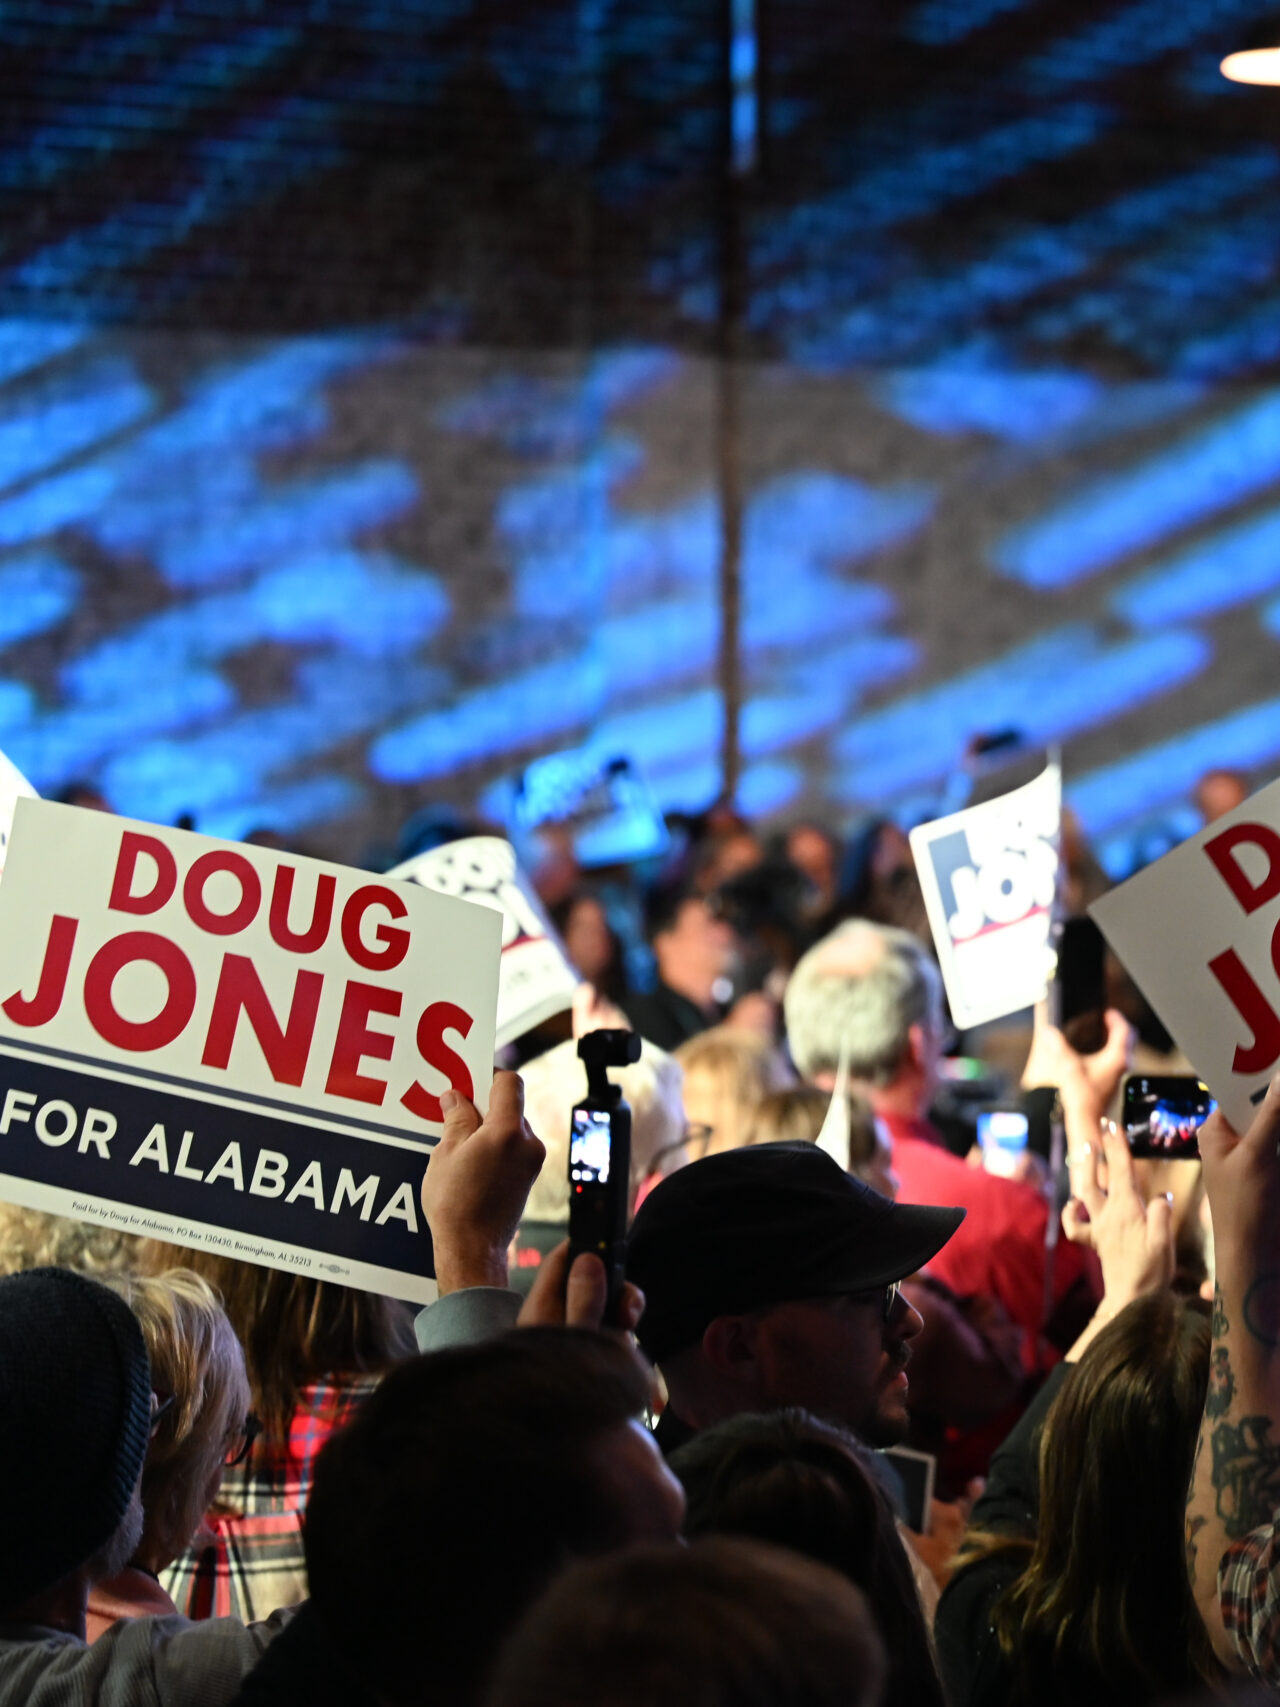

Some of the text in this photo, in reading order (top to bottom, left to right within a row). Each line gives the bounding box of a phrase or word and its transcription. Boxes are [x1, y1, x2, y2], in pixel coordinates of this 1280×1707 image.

[107, 830, 411, 971] DOUG
[2, 914, 475, 1123] JONES
[0, 1088, 419, 1234] FOR ALABAMA
[72, 1200, 87, 1212] Paid
[88, 1203, 98, 1214] for
[99, 1208, 109, 1218] by
[110, 1211, 128, 1224] Doug
[130, 1215, 140, 1224] for
[141, 1219, 174, 1234] Alabama,
[176, 1227, 188, 1236] PO
[188, 1230, 202, 1240] Box
[234, 1241, 276, 1260] Birmingham,
[278, 1252, 287, 1261] AL
[289, 1253, 312, 1267] 35213
